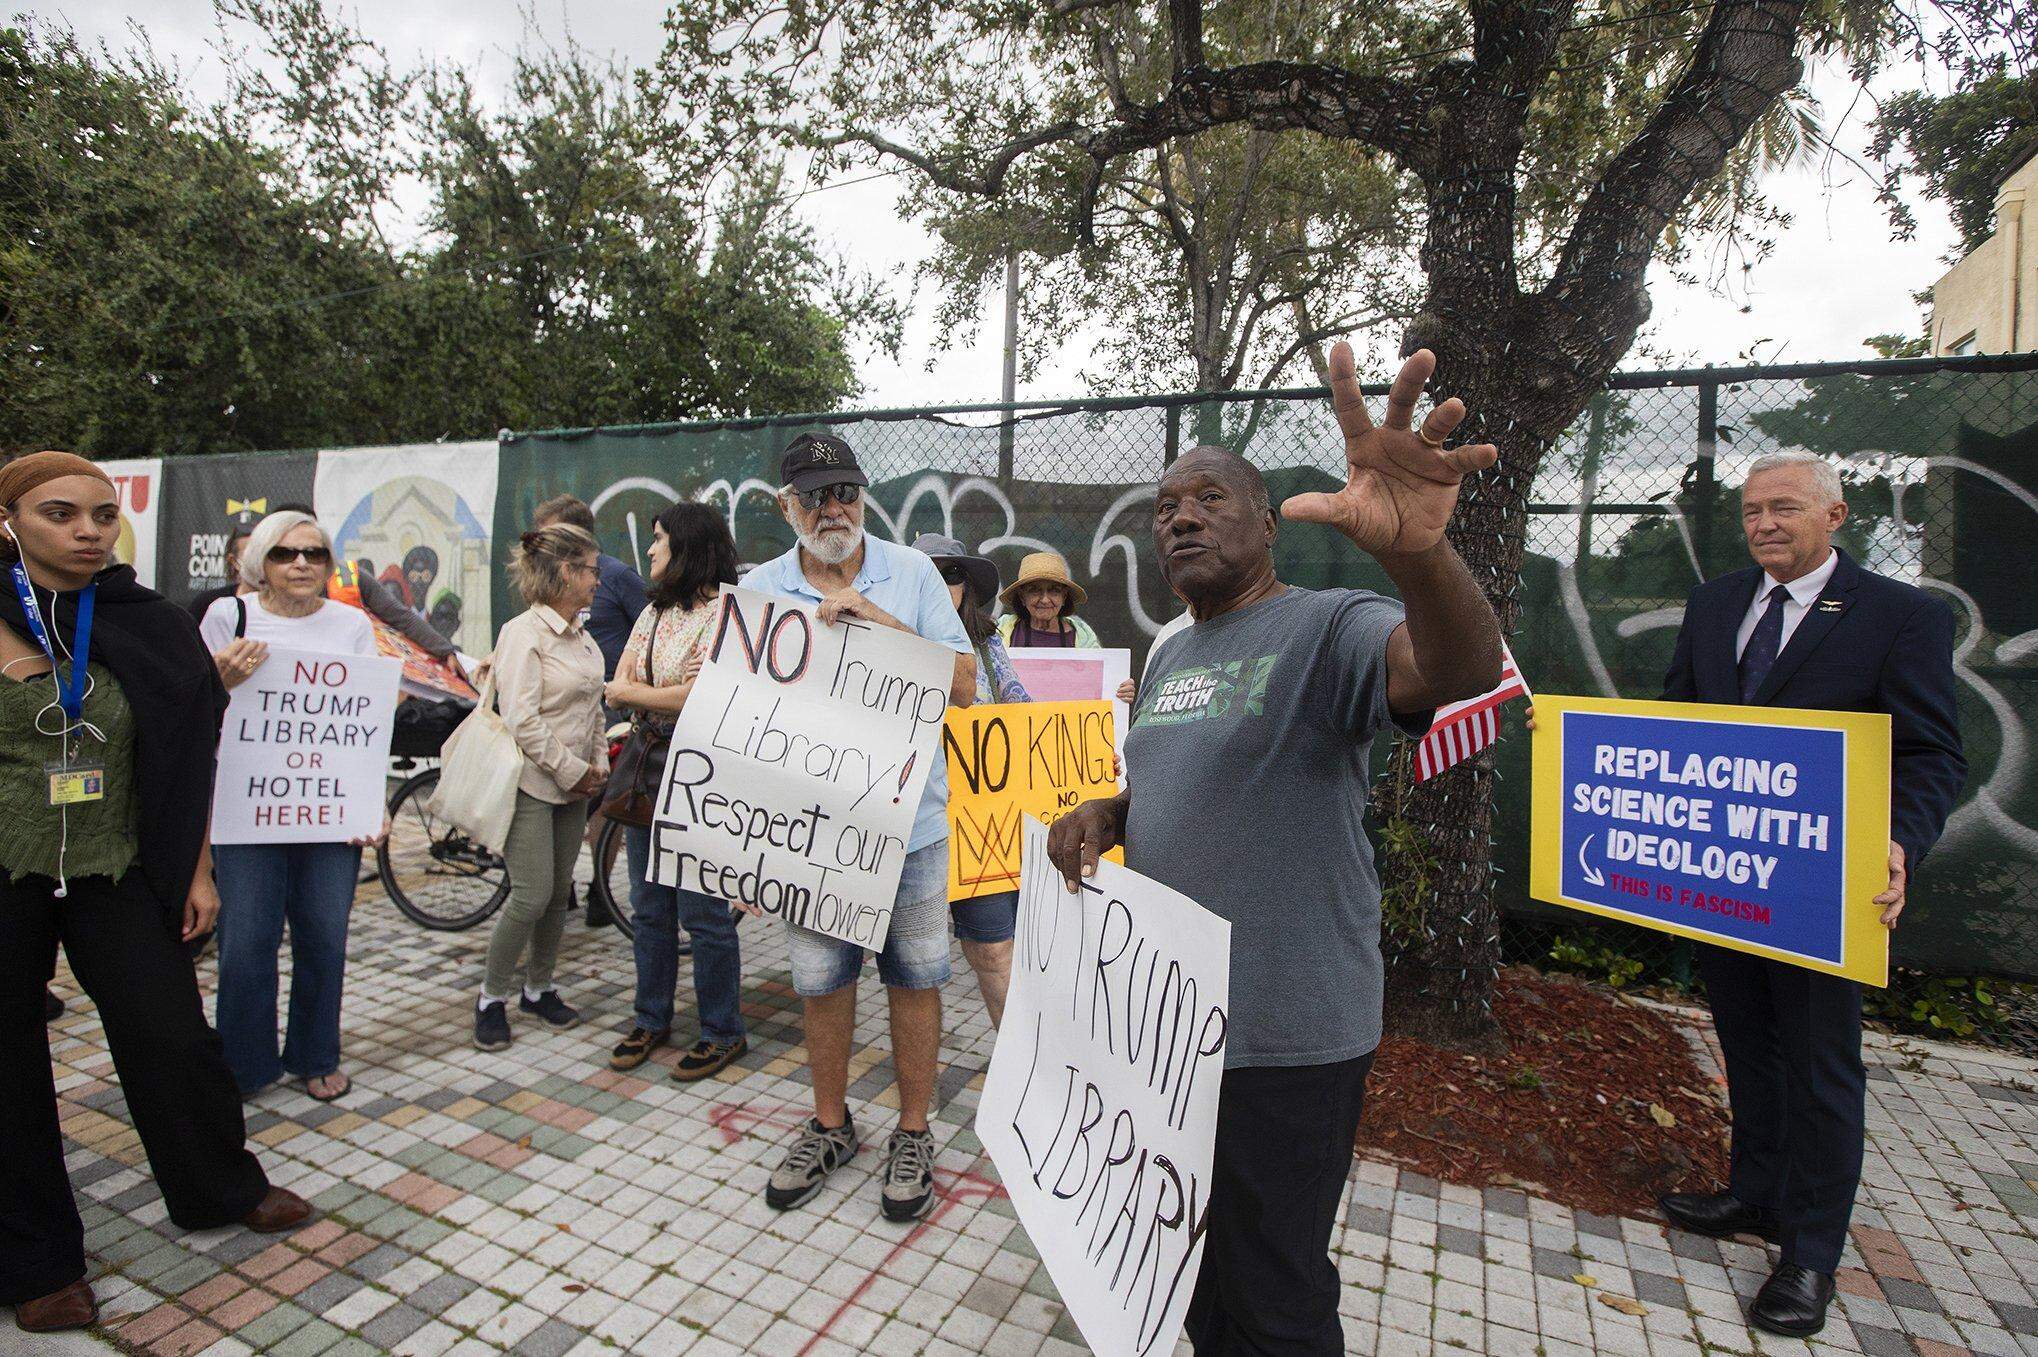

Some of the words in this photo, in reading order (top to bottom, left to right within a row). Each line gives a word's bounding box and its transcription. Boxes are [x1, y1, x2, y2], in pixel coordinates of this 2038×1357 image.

[293, 660, 347, 687] NO
[709, 593, 813, 684] NO
[830, 620, 946, 743] Trump
[1159, 675, 1205, 696] TEACH
[258, 690, 371, 718] TRUMP
[1153, 686, 1216, 713] TRUTH
[239, 718, 378, 748] LIBRARY
[711, 685, 917, 811] Library!
[943, 716, 1010, 795] NO
[1029, 711, 1117, 790] KINGS
[248, 776, 346, 798] HOTEL
[286, 752, 323, 769] OR
[1594, 744, 1798, 797] REPLACING
[254, 804, 345, 826] HERE!
[662, 748, 829, 857] Respect
[836, 825, 905, 875] our
[1058, 791, 1078, 808] NO
[1572, 783, 1713, 833] SCIENCE
[1727, 803, 1830, 852] WITH
[652, 821, 810, 925] Freedom
[808, 863, 892, 945] Tower
[1606, 828, 1779, 890] IDEOLOGY
[1608, 871, 1650, 899] THIS
[1656, 887, 1673, 903] IS
[1679, 888, 1772, 925] FASCISM
[1072, 881, 1227, 1131] TRUMP
[1012, 1011, 1209, 1357] LIBRARY
